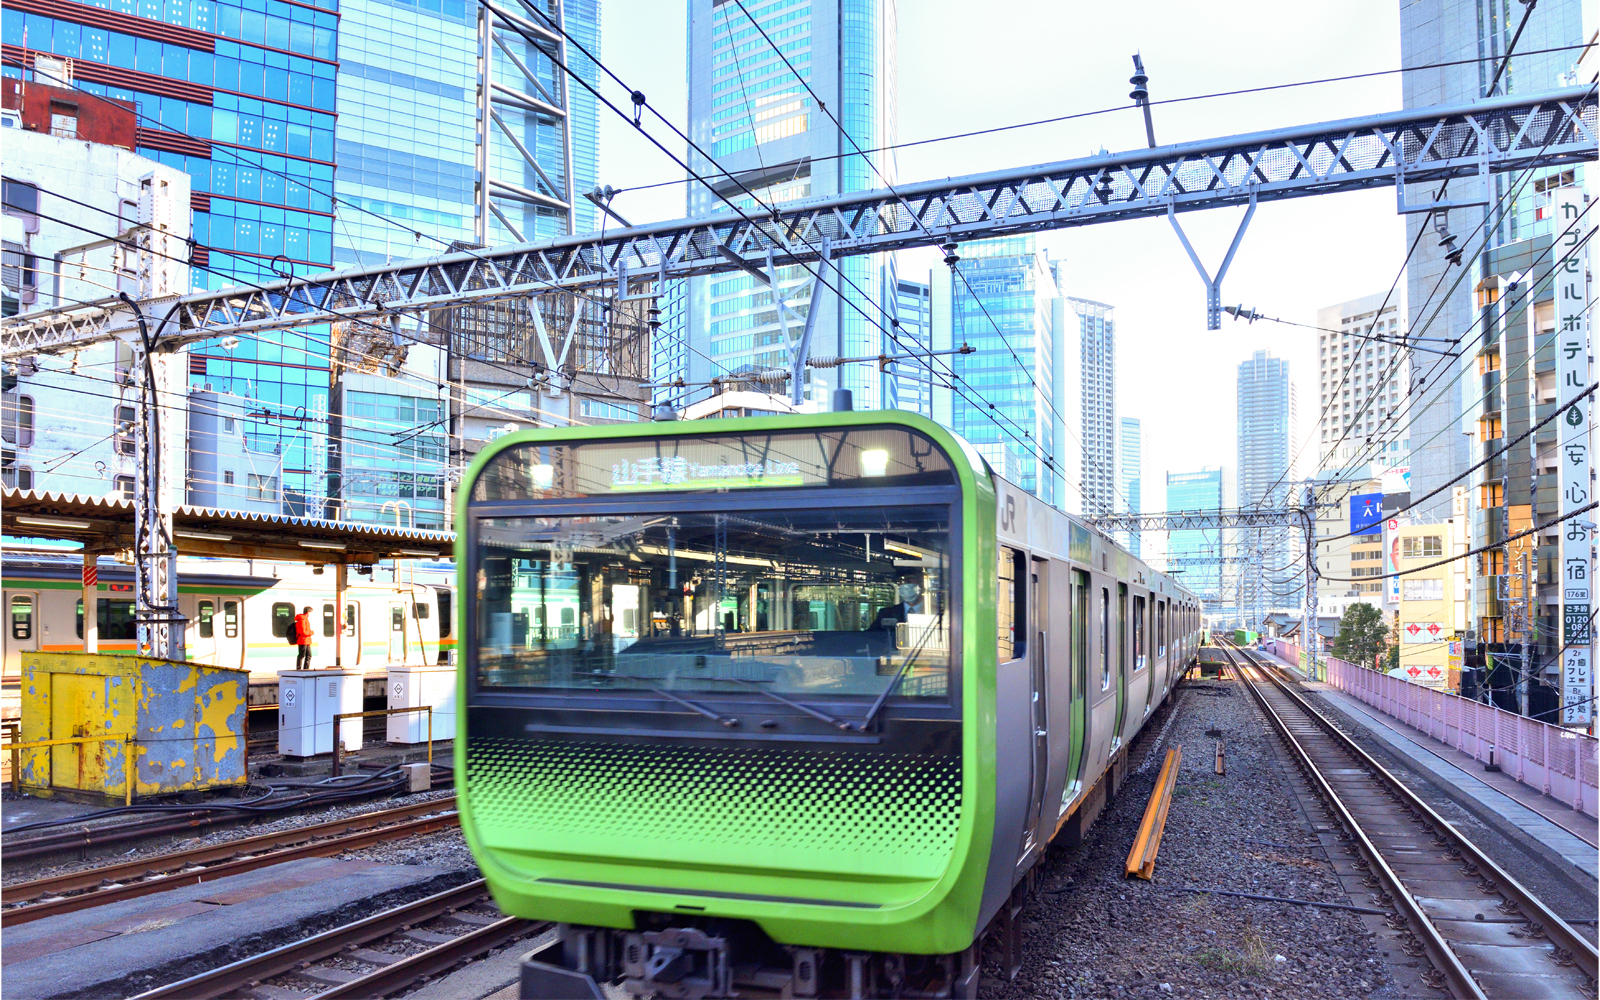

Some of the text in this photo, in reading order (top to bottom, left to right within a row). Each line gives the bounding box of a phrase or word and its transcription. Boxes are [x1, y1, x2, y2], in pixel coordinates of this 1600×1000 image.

[1561, 202, 1587, 580] カプセルホテル 安心お宿
[612, 455, 688, 485] 山手線
[1001, 493, 1015, 534] JR
[1565, 615, 1589, 624] 0120
[1566, 605, 1588, 613] ご予約
